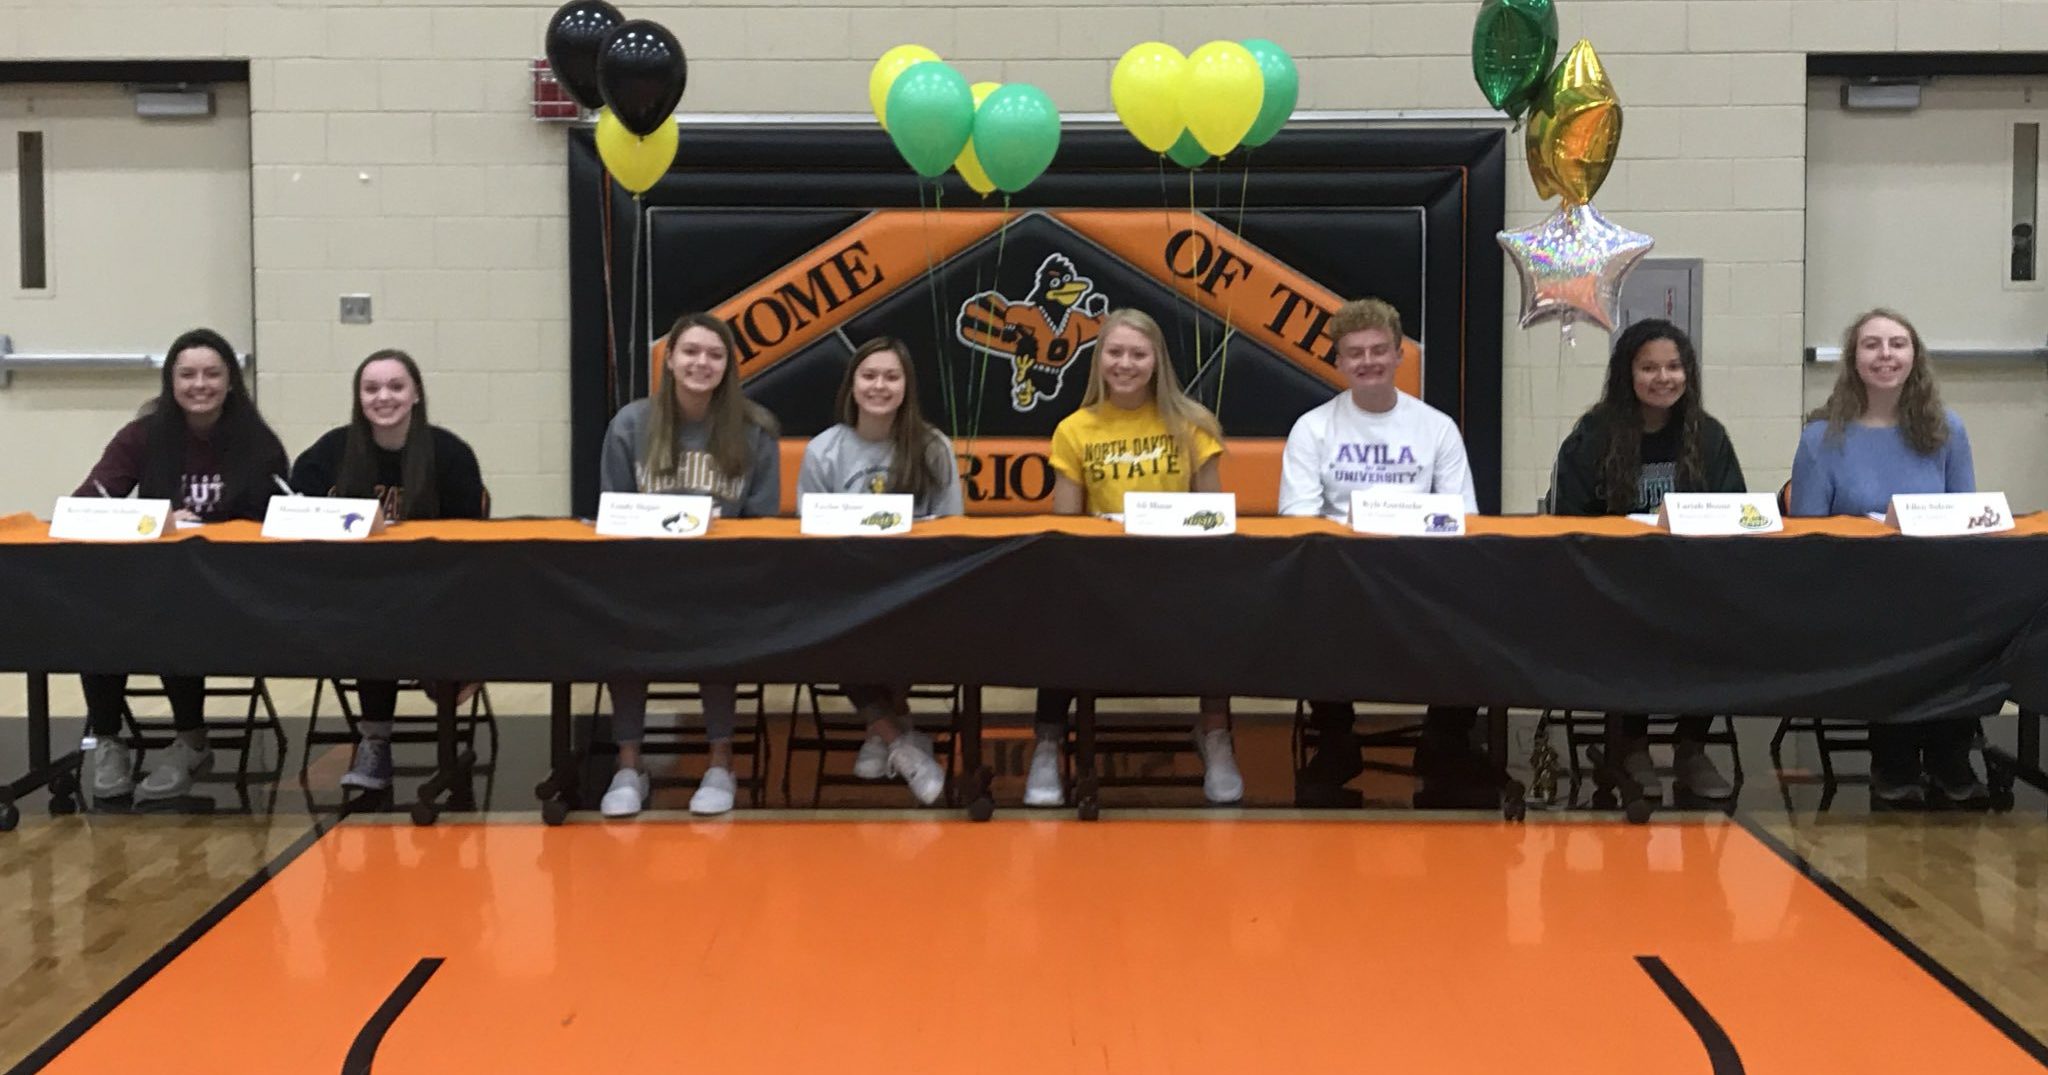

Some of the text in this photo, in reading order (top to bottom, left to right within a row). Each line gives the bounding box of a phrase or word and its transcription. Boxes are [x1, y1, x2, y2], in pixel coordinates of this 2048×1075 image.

[1165, 229, 1254, 298] OF
[1264, 283, 1338, 368] TH
[1084, 439, 1127, 462] NORTH
[1336, 443, 1417, 465] AVILA
[633, 451, 746, 500] MHIGAN
[1089, 453, 1180, 482] STATE
[1334, 470, 1418, 484] UNIVERSITY
